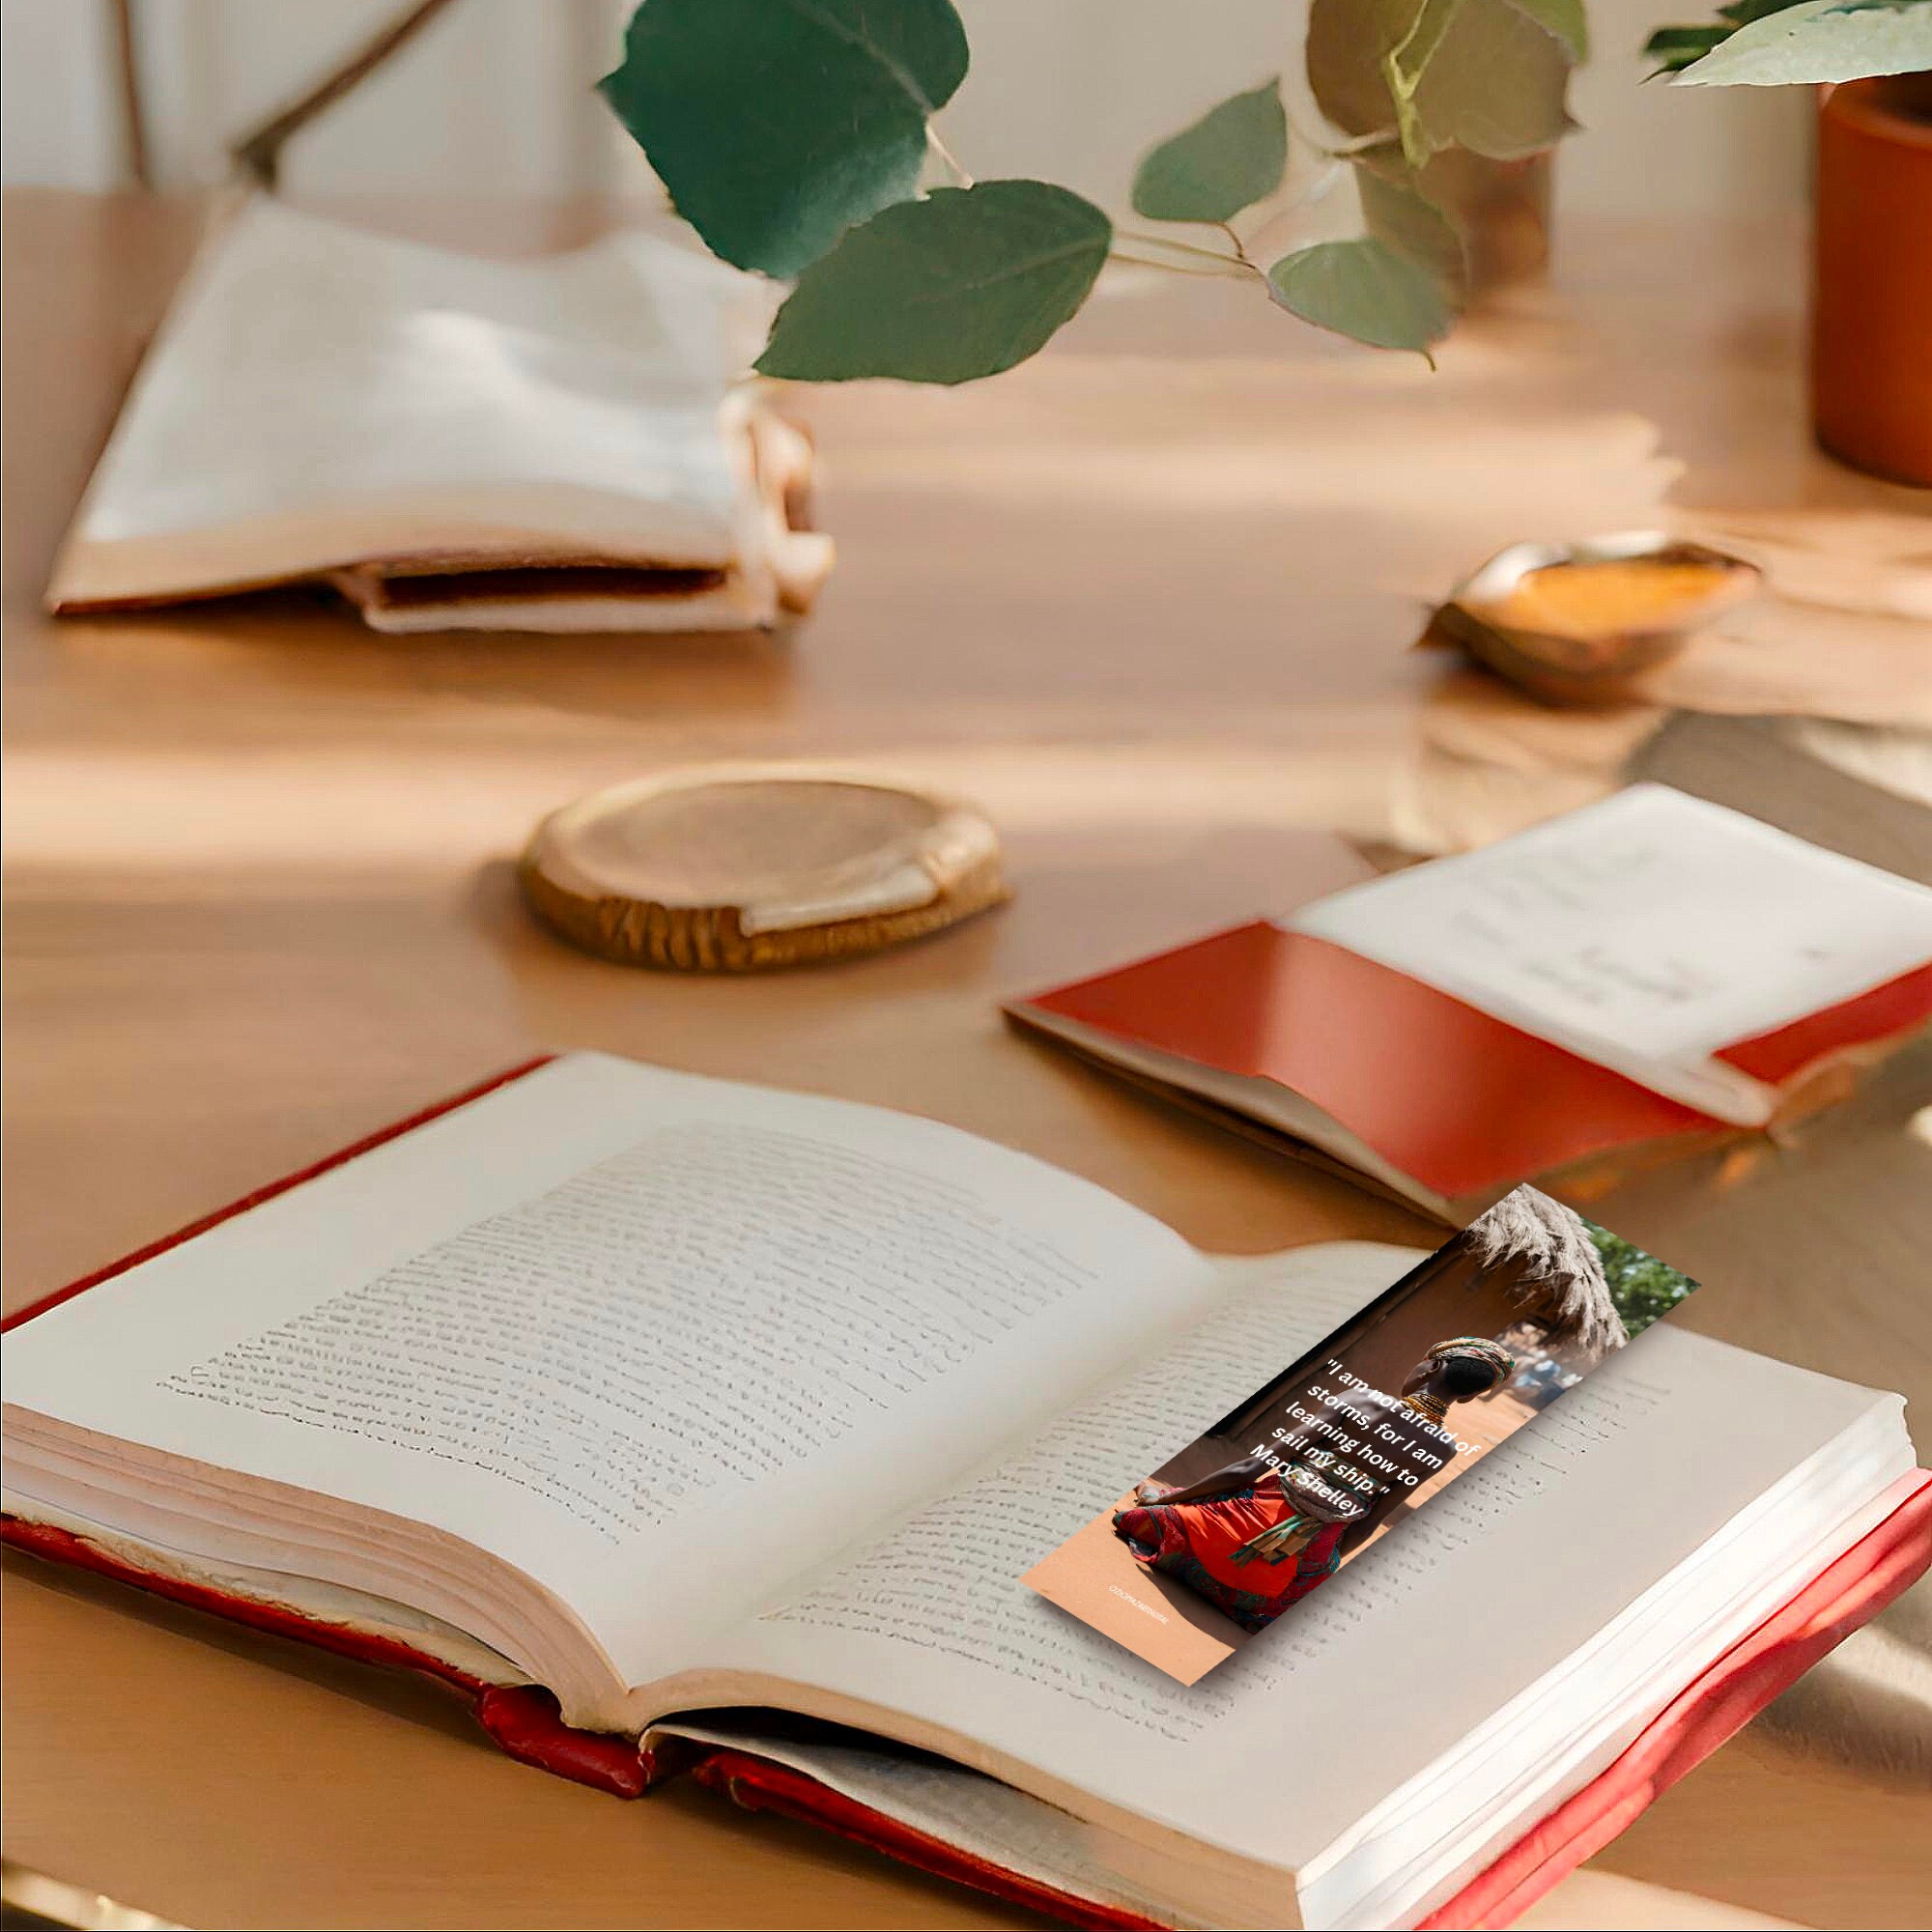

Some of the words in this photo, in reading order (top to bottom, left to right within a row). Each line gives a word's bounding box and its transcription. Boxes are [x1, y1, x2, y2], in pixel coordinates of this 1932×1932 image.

[1286, 1401, 1360, 1453] learning
[1356, 1443, 1399, 1473] how
[1396, 1468, 1418, 1486] to
[1307, 1385, 1371, 1431] storms,
[1374, 1423, 1405, 1444] for
[1402, 1439, 1417, 1451] I
[1411, 1448, 1443, 1469] am
[1327, 1358, 1344, 1376] "I
[1338, 1372, 1369, 1393] am
[1368, 1389, 1405, 1413] not
[1400, 1408, 1459, 1444] afraid
[1455, 1441, 1482, 1457] of
[1249, 1443, 1297, 1476] Mary
[1296, 1472, 1364, 1517] Shelley
[1271, 1427, 1309, 1451] sail
[1303, 1447, 1336, 1468] my
[1333, 1465, 1374, 1494] ship.
